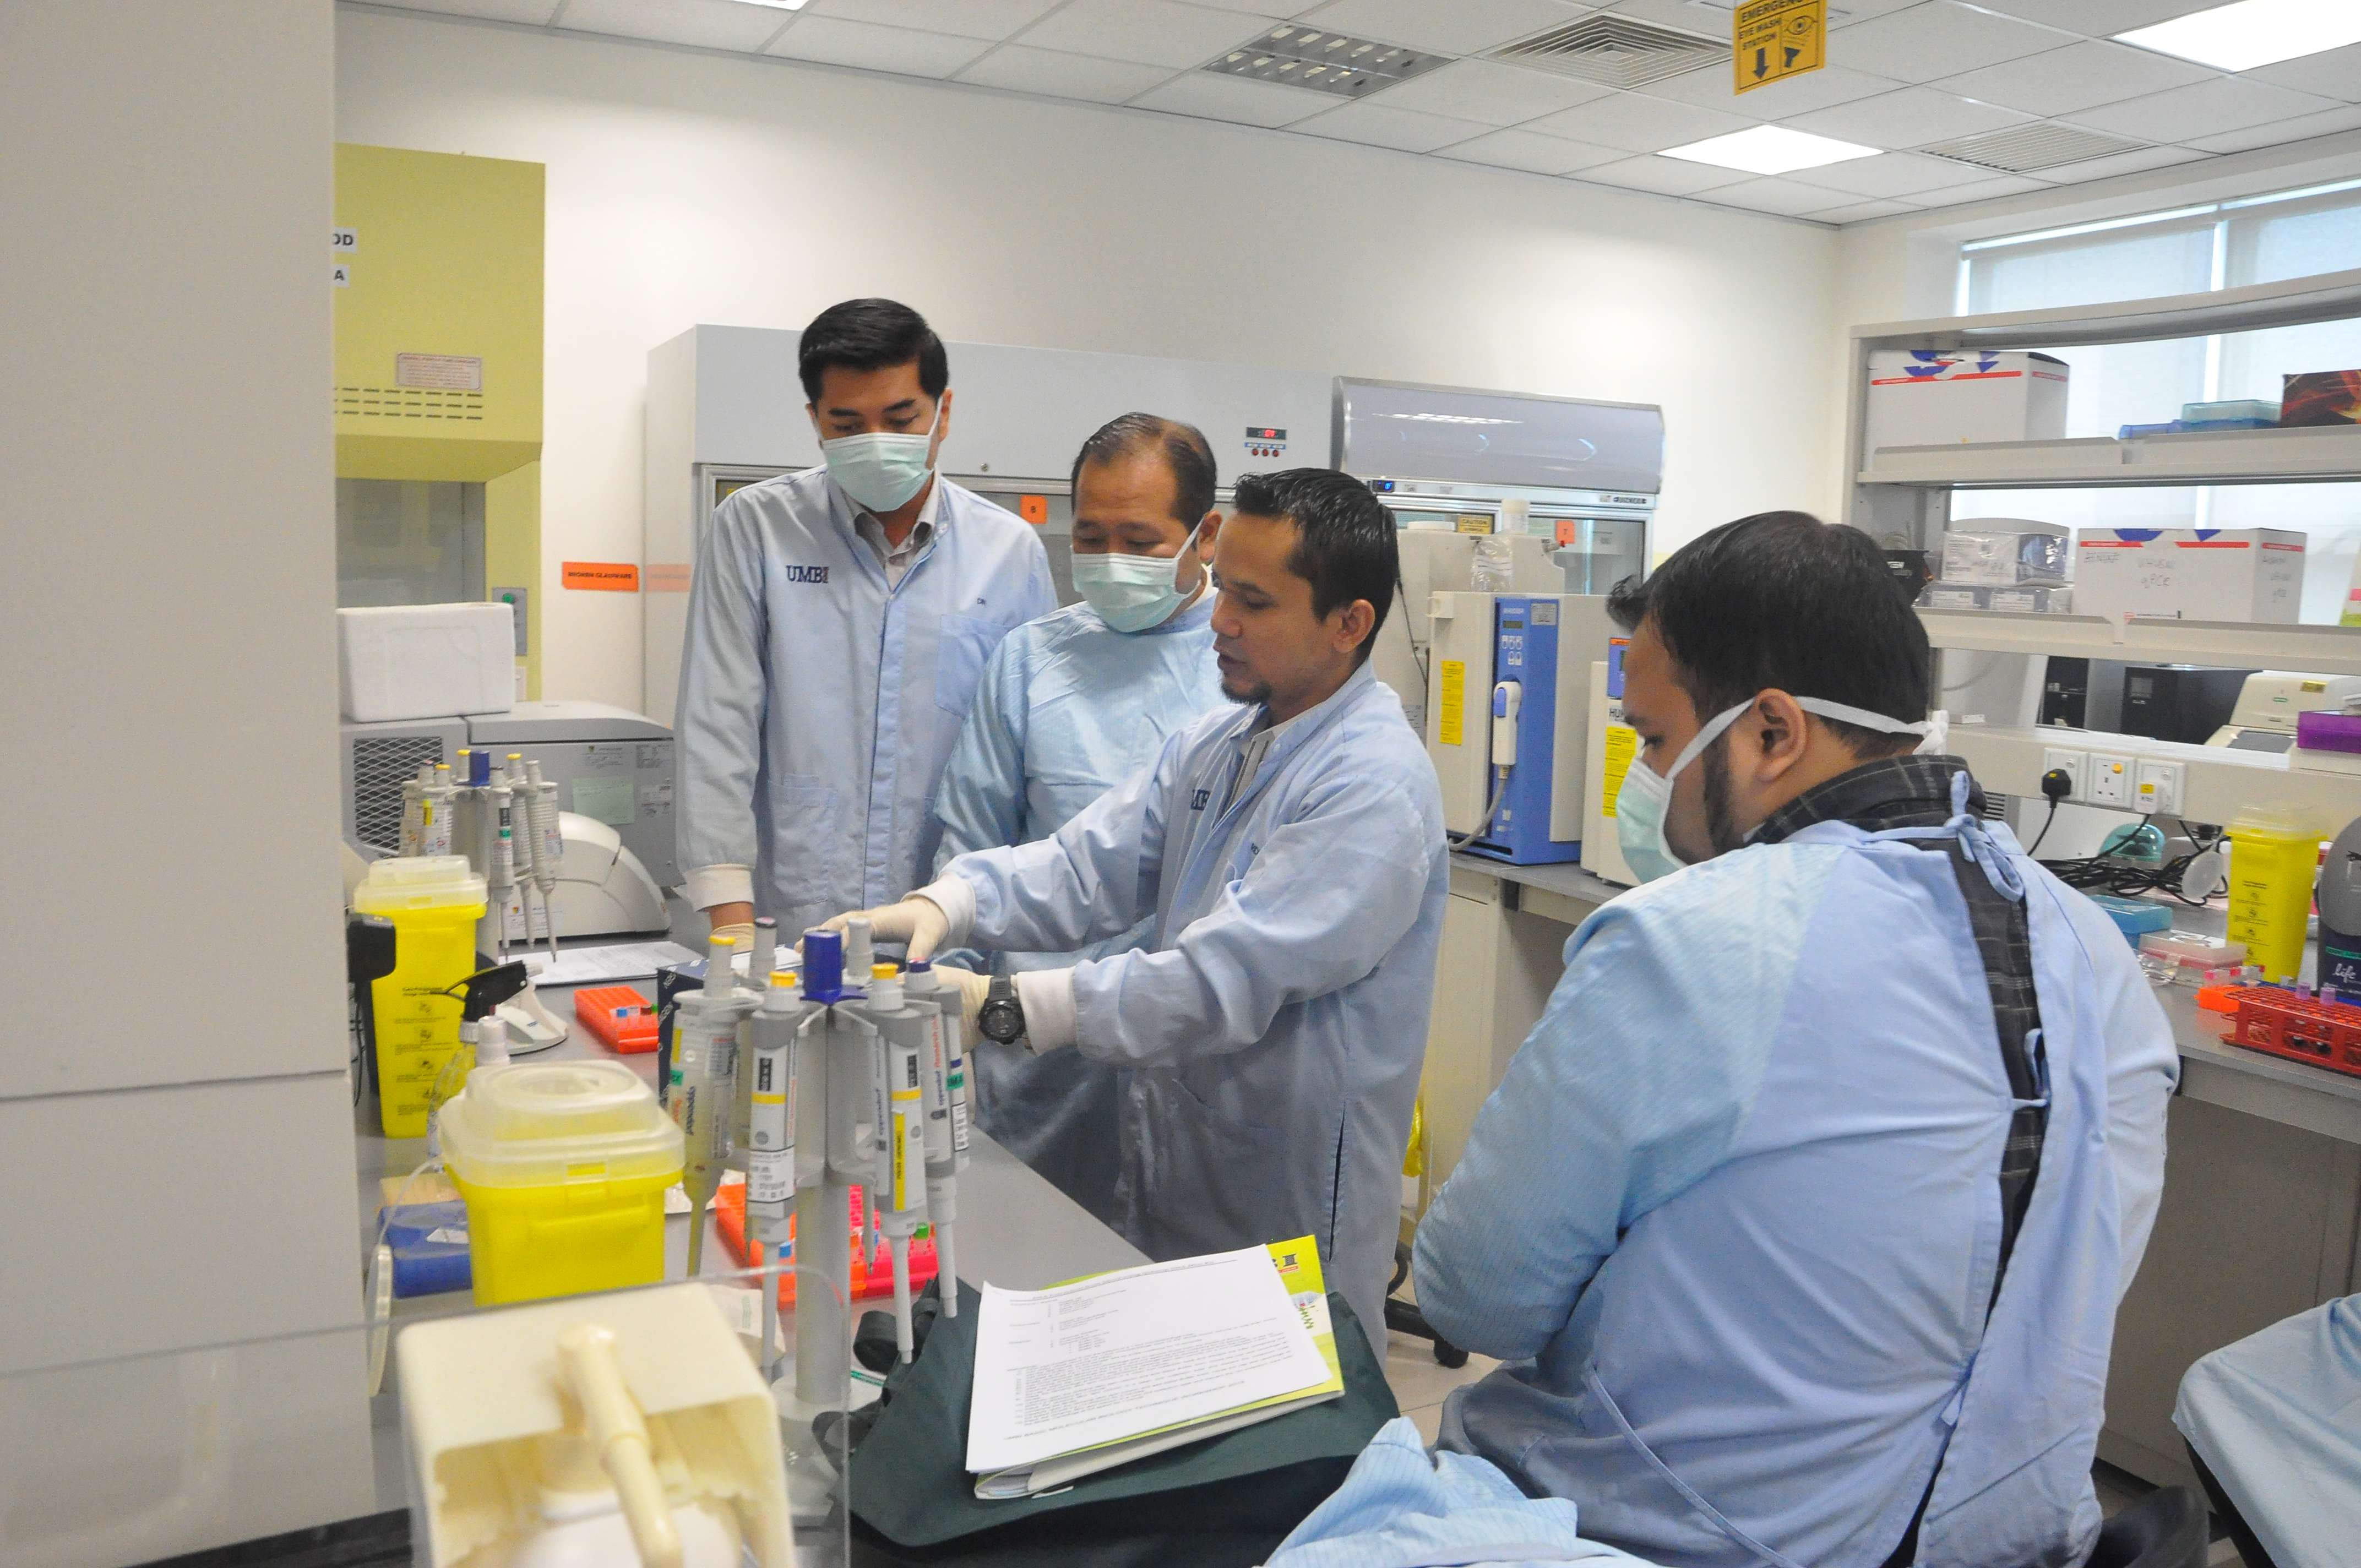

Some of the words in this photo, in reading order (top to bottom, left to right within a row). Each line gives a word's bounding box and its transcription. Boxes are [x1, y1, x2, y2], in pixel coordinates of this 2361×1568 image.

[1742, 0, 1803, 22] EMERGE
[786, 565, 829, 584] UMBI
[2332, 963, 2356, 983] life
